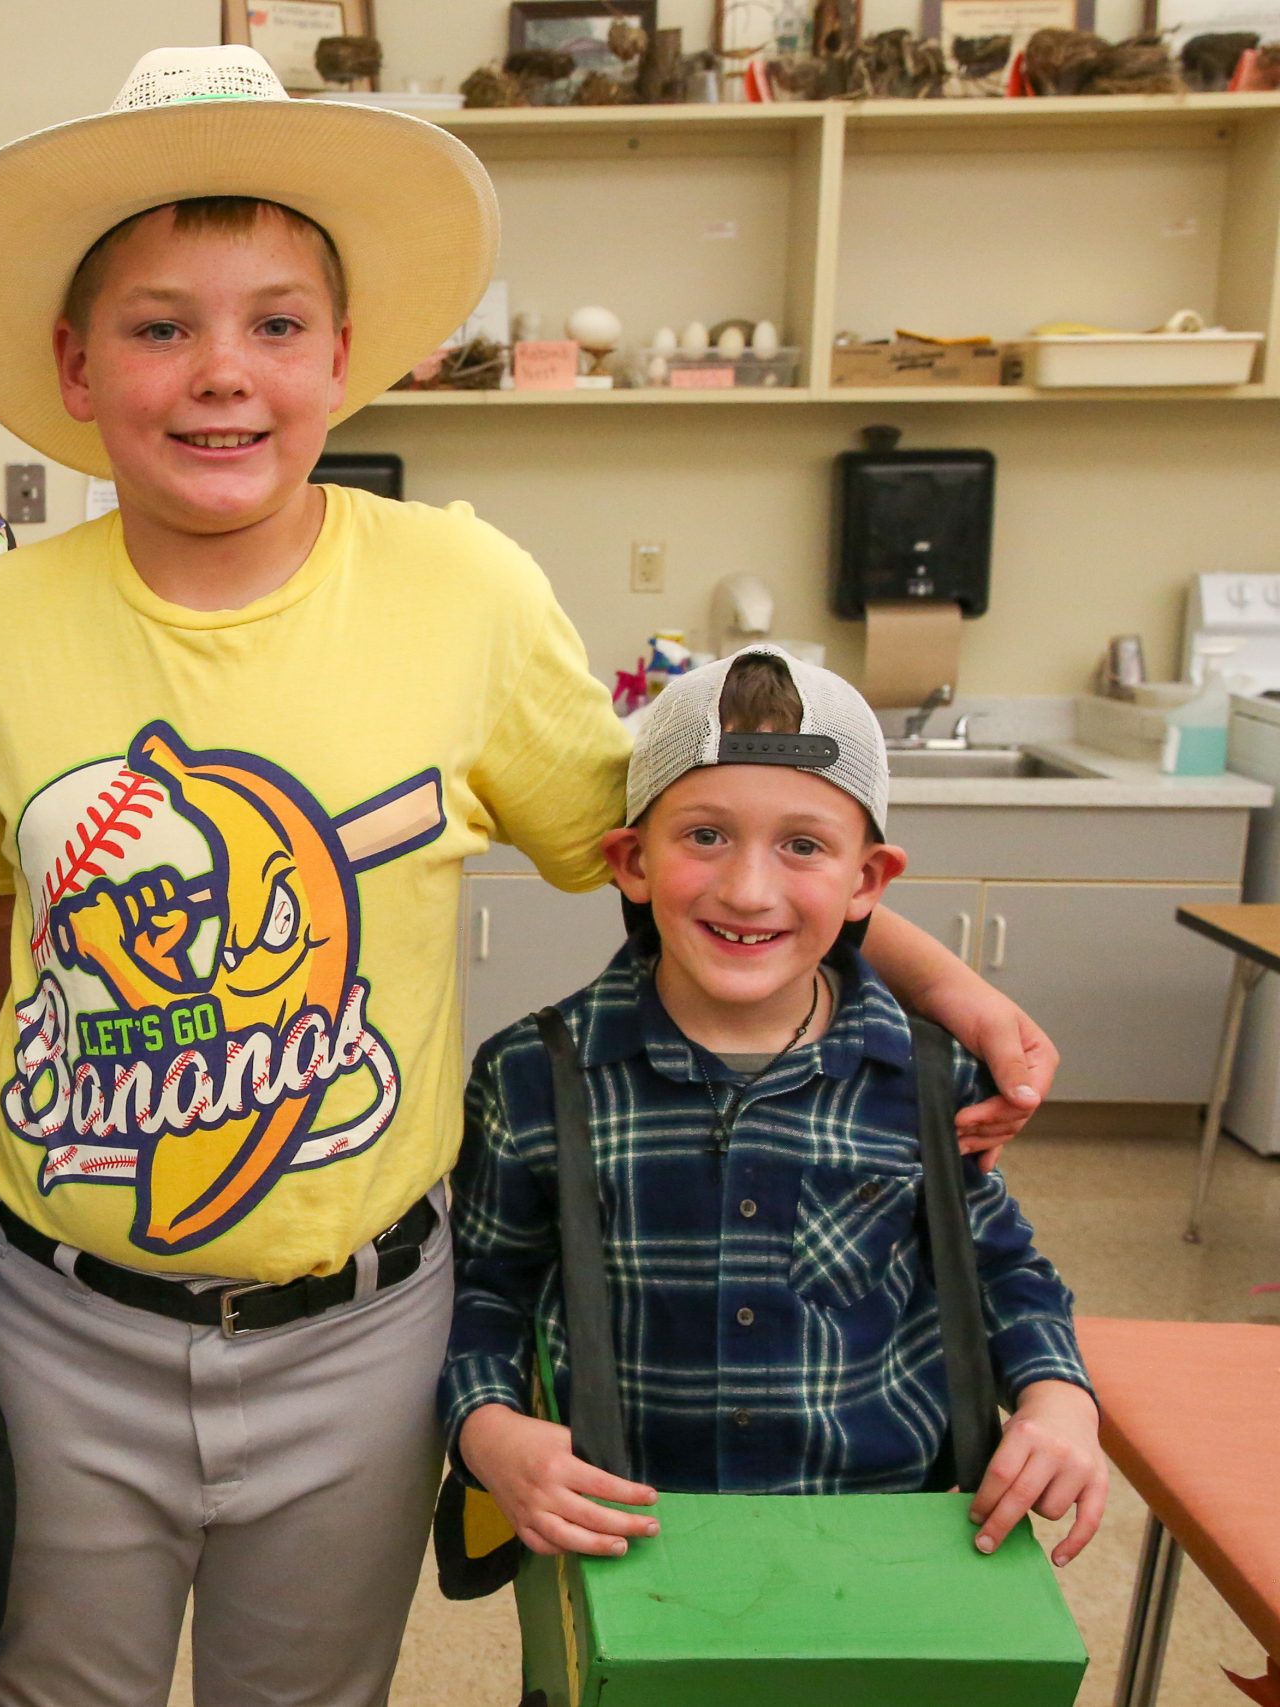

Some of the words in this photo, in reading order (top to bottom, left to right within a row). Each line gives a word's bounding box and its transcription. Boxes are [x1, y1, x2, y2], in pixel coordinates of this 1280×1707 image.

[6, 978, 375, 1140] Bananas
[80, 1014, 163, 1056] LET'S
[172, 1003, 218, 1046] GO
